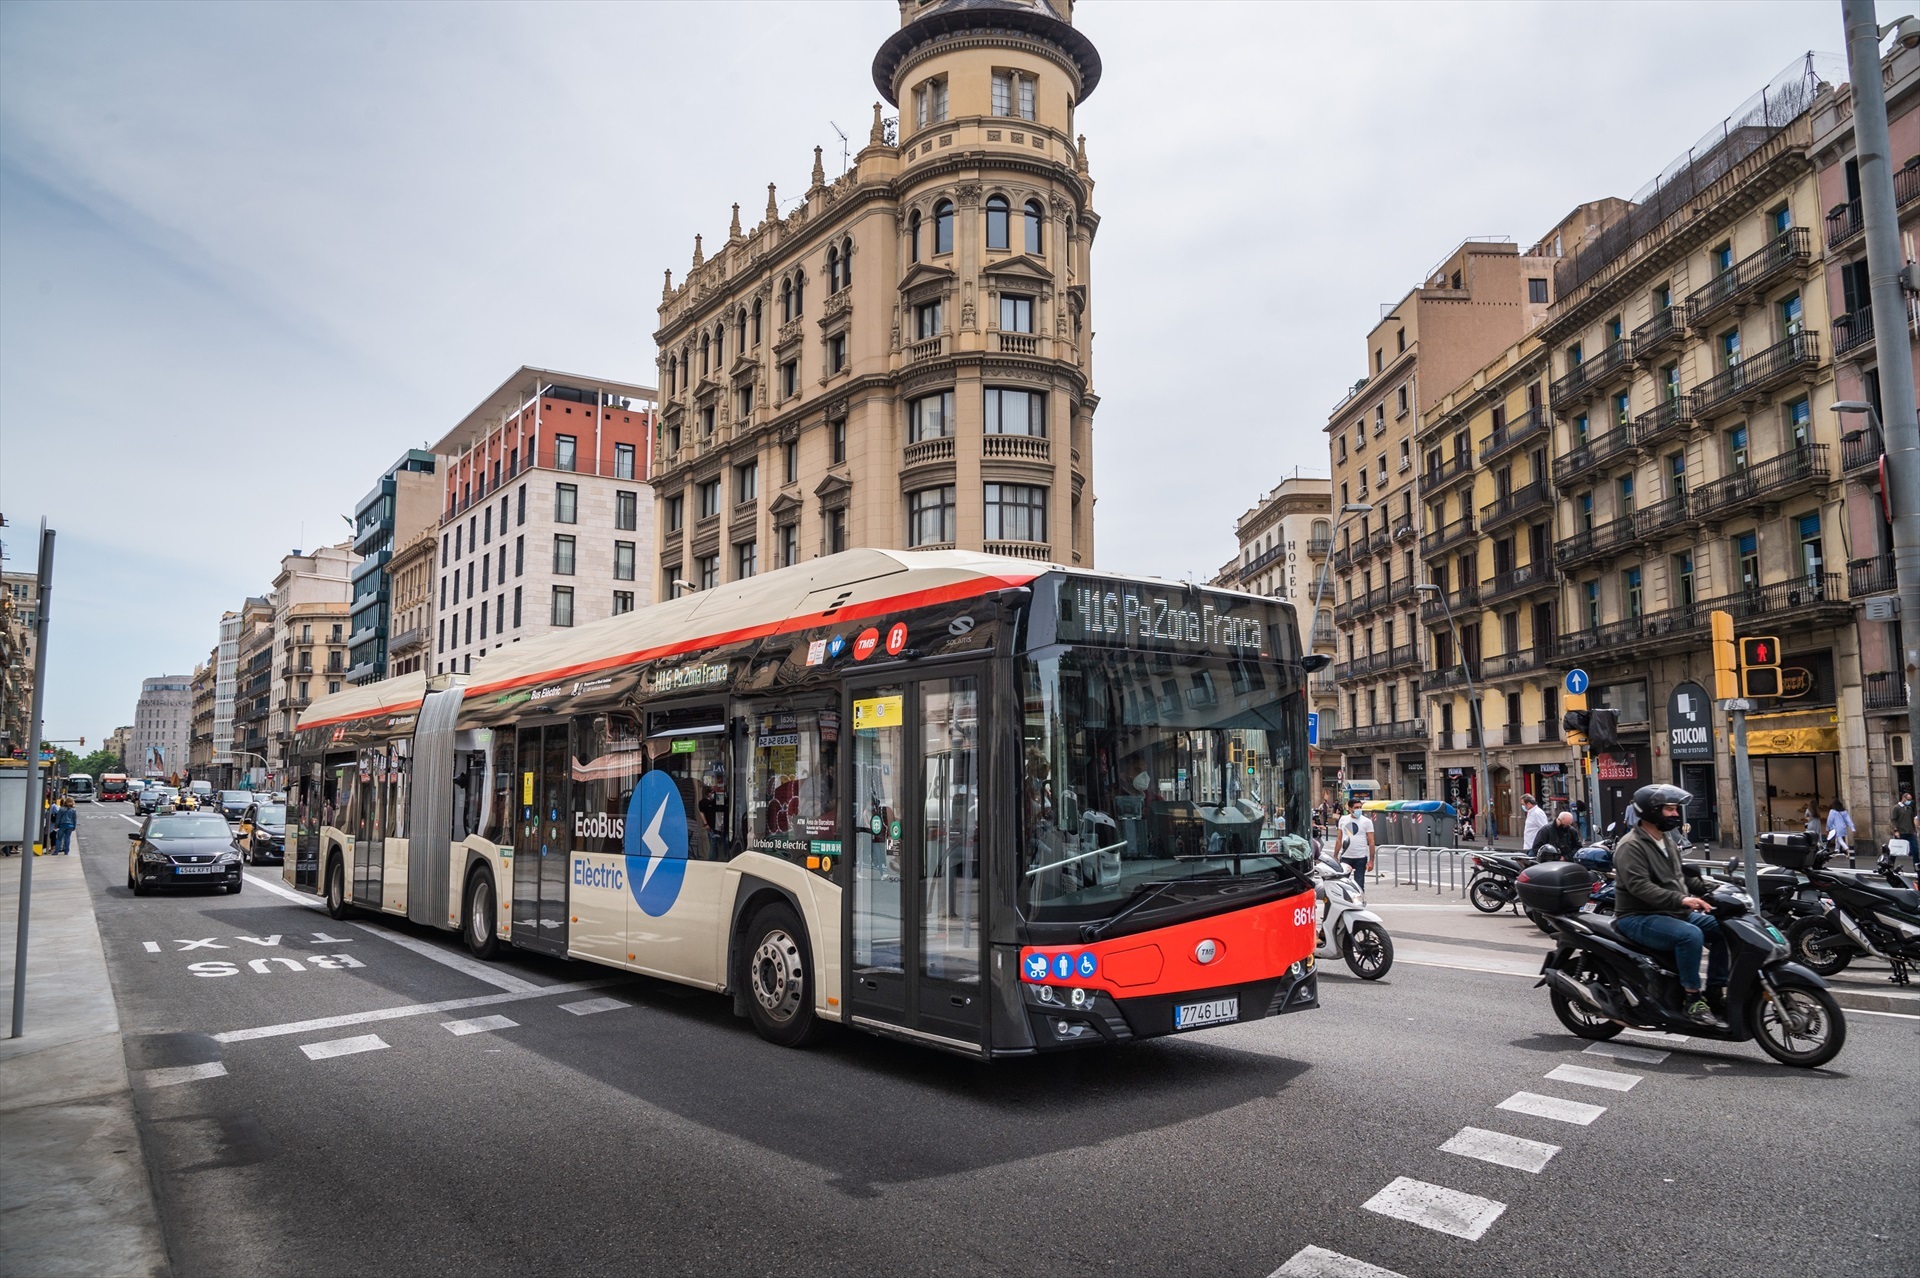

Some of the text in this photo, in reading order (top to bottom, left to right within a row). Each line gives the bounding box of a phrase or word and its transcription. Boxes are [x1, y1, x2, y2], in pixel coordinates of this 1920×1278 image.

[1288, 540, 1297, 599] HOTEL
[831, 640, 841, 651] W
[857, 638, 876, 650] TMB
[945, 636, 972, 646] SOLARIS
[655, 669, 672, 692] H16
[531, 690, 541, 700] Bus
[1672, 727, 1707, 744] STUCOM
[575, 811, 624, 839] EcoBus
[753, 838, 774, 848] Urbino
[774, 839, 782, 848] 18
[782, 840, 807, 851] electric
[574, 858, 623, 890] Elèctric
[1293, 906, 1316, 927] 8614
[142, 932, 353, 953] TAXI
[1201, 948, 1214, 956] TMB
[187, 953, 368, 978] BUS
[1182, 1000, 1235, 1022] 7746 LLV
